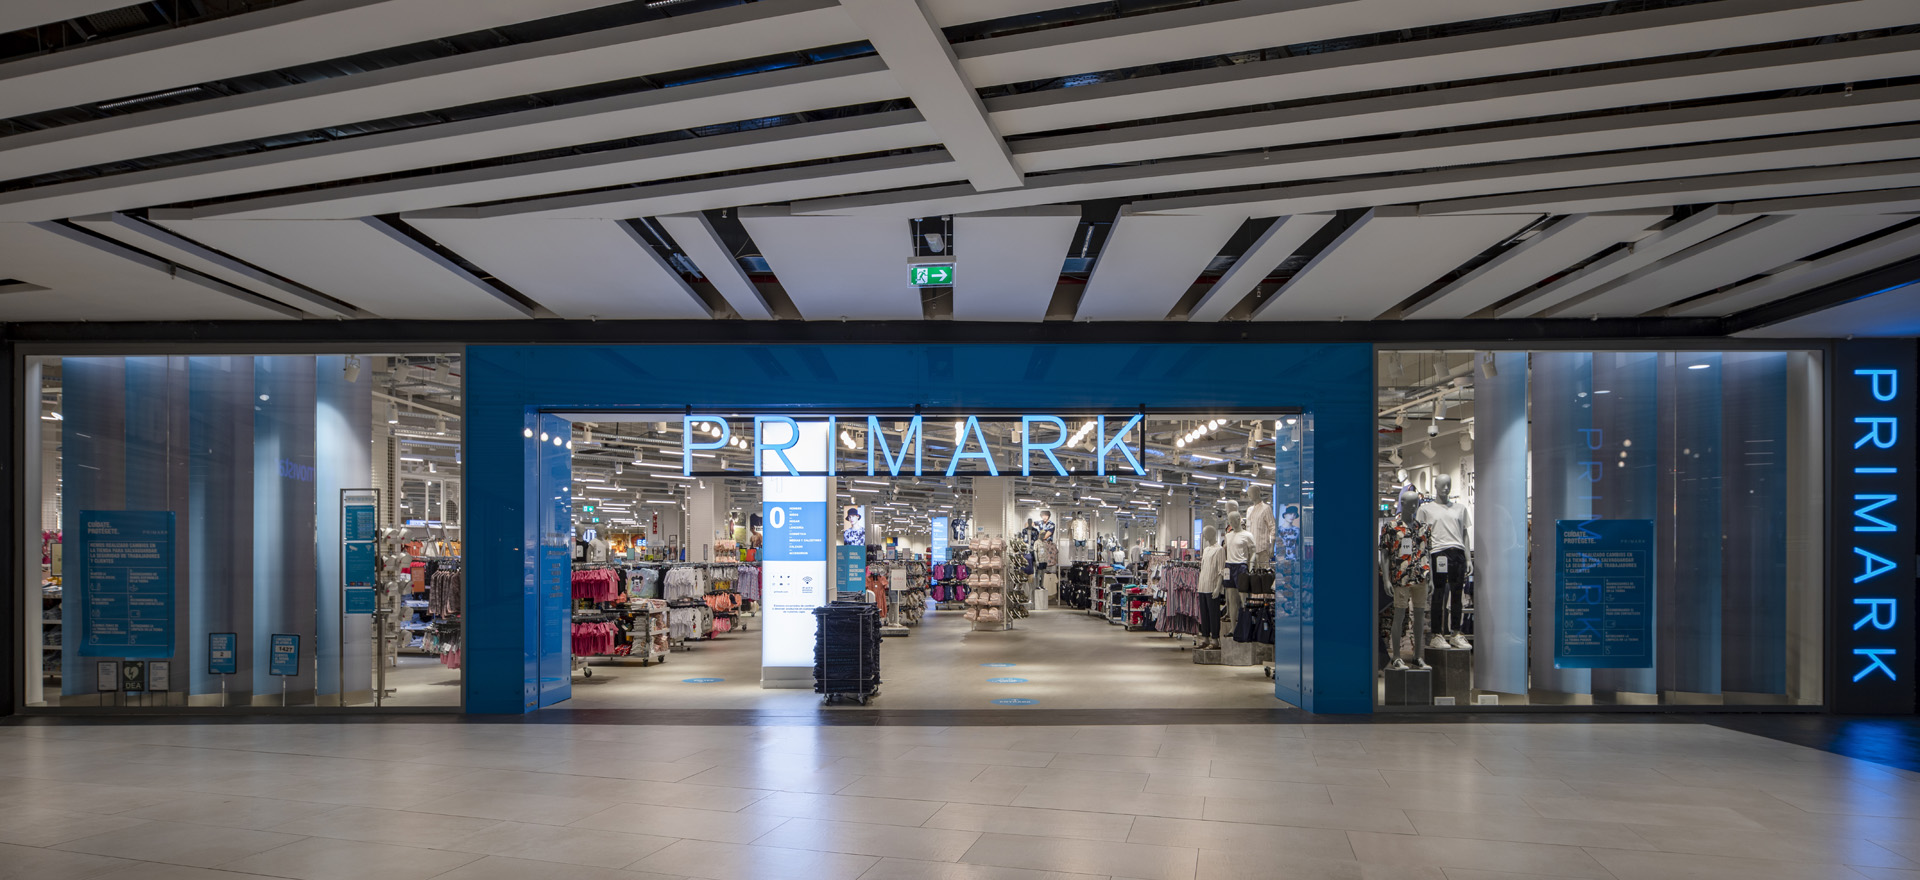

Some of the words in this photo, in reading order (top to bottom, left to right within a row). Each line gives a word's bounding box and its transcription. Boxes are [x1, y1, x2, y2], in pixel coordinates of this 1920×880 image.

[683, 414, 1147, 477] PRIMARK
[770, 507, 786, 528] 0
[1853, 369, 1897, 682] PRIMARK
